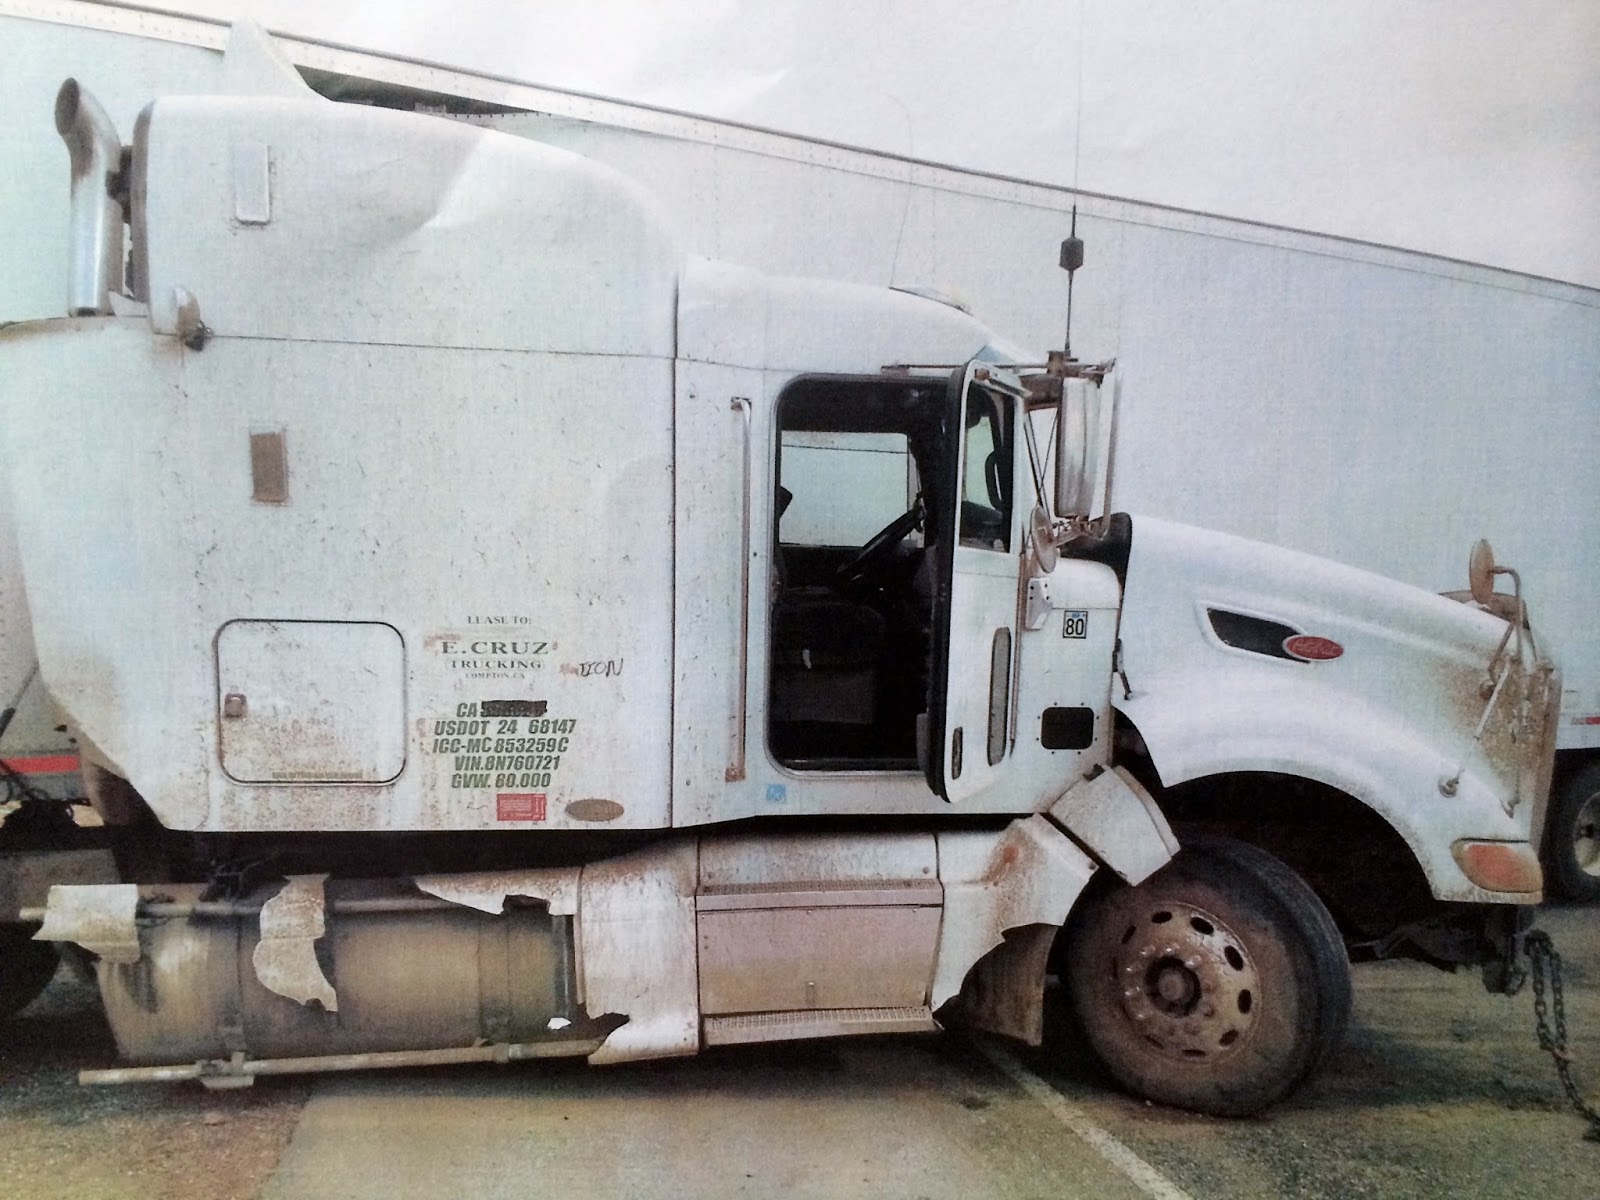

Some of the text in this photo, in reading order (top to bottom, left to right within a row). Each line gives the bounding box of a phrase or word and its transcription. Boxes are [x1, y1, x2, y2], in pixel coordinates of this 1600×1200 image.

[467, 615, 508, 625] LEASE
[1065, 617, 1085, 636] 80
[441, 641, 549, 655] E.CRUZ
[452, 660, 542, 669] TRUCKING
[456, 702, 478, 718] CA
[434, 719, 577, 736] USDOT 24 68147
